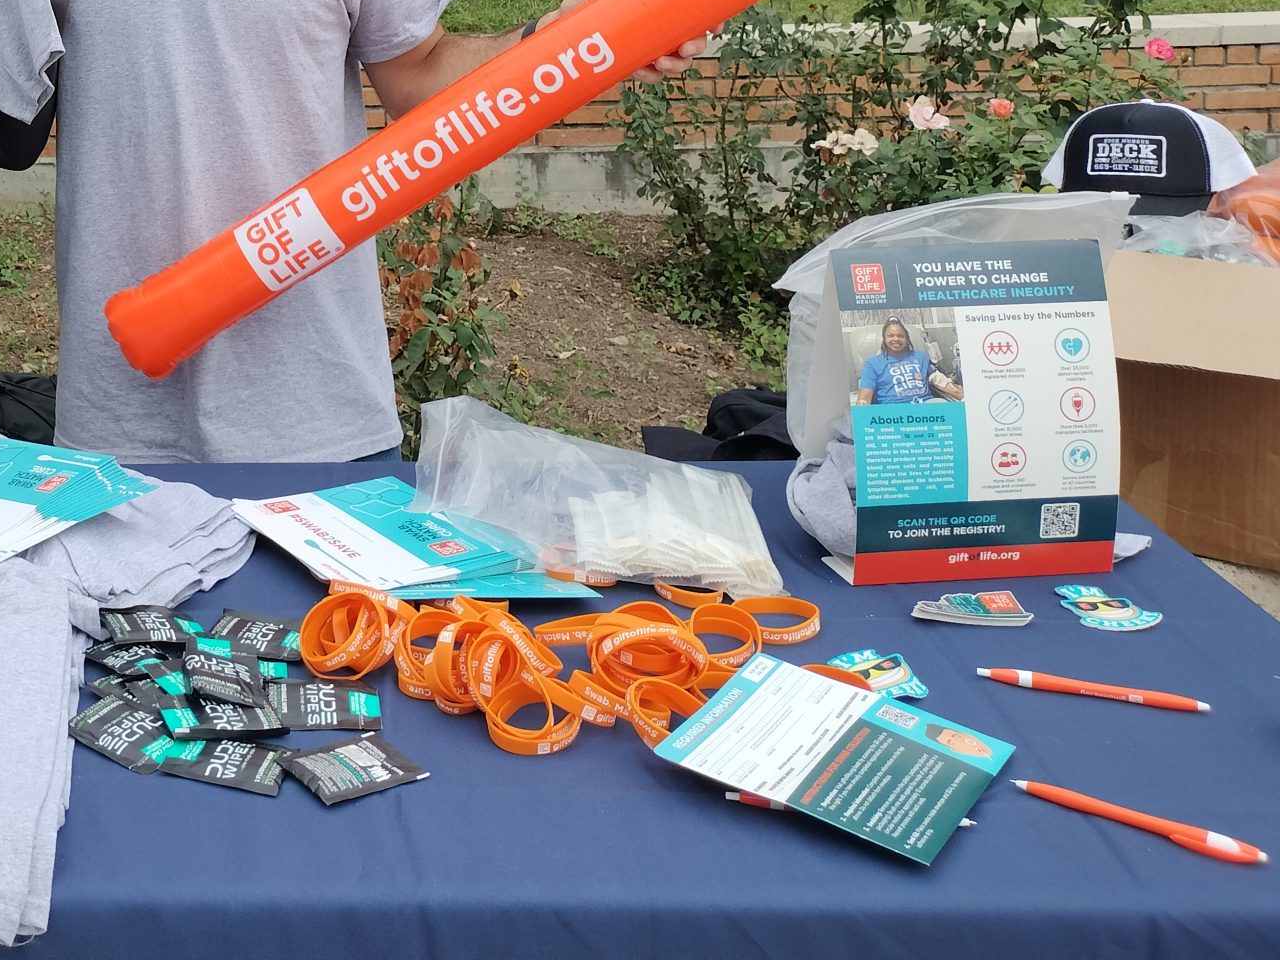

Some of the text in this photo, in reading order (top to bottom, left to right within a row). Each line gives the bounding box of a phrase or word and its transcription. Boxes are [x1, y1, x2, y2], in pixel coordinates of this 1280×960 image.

[341, 32, 615, 221] giftoflife.org
[1096, 143, 1157, 159] DECK
[246, 196, 304, 244] GIFT
[257, 229, 294, 266] OF
[269, 240, 331, 284] LIFE
[913, 260, 1013, 273] YOU HAVE THE
[855, 267, 879, 275] GIFT
[857, 283, 881, 291] LIFE
[916, 272, 1049, 287] POWER TO CHANGE
[917, 285, 1075, 301] HEALTHCARE INEQUITY
[965, 314, 996, 323] Saving
[998, 313, 1021, 321] Lives
[1023, 313, 1035, 321] by
[1055, 311, 1095, 319] Numbers
[890, 364, 920, 375] GIFT
[870, 415, 945, 425] About Donors
[422, 520, 453, 537] CURE
[898, 515, 997, 528] SCAN THE QR CODE
[289, 513, 362, 559] #SWAB2SAVE
[888, 525, 1006, 539] TO JOIN THE REGISTRY!
[949, 552, 1020, 564] giftoflife.org
[1061, 587, 1104, 598] I'M
[612, 625, 678, 645] giftoflife.org
[763, 622, 815, 640] giftoflife.org
[499, 620, 547, 674] giftoflife.org
[832, 650, 876, 668] I'M
[584, 687, 612, 708] Swab.
[670, 687, 745, 750] REQUIRED INFORMATION
[799, 770, 834, 805] INSTRUCTIONS
[844, 726, 871, 752] COLLECTION
